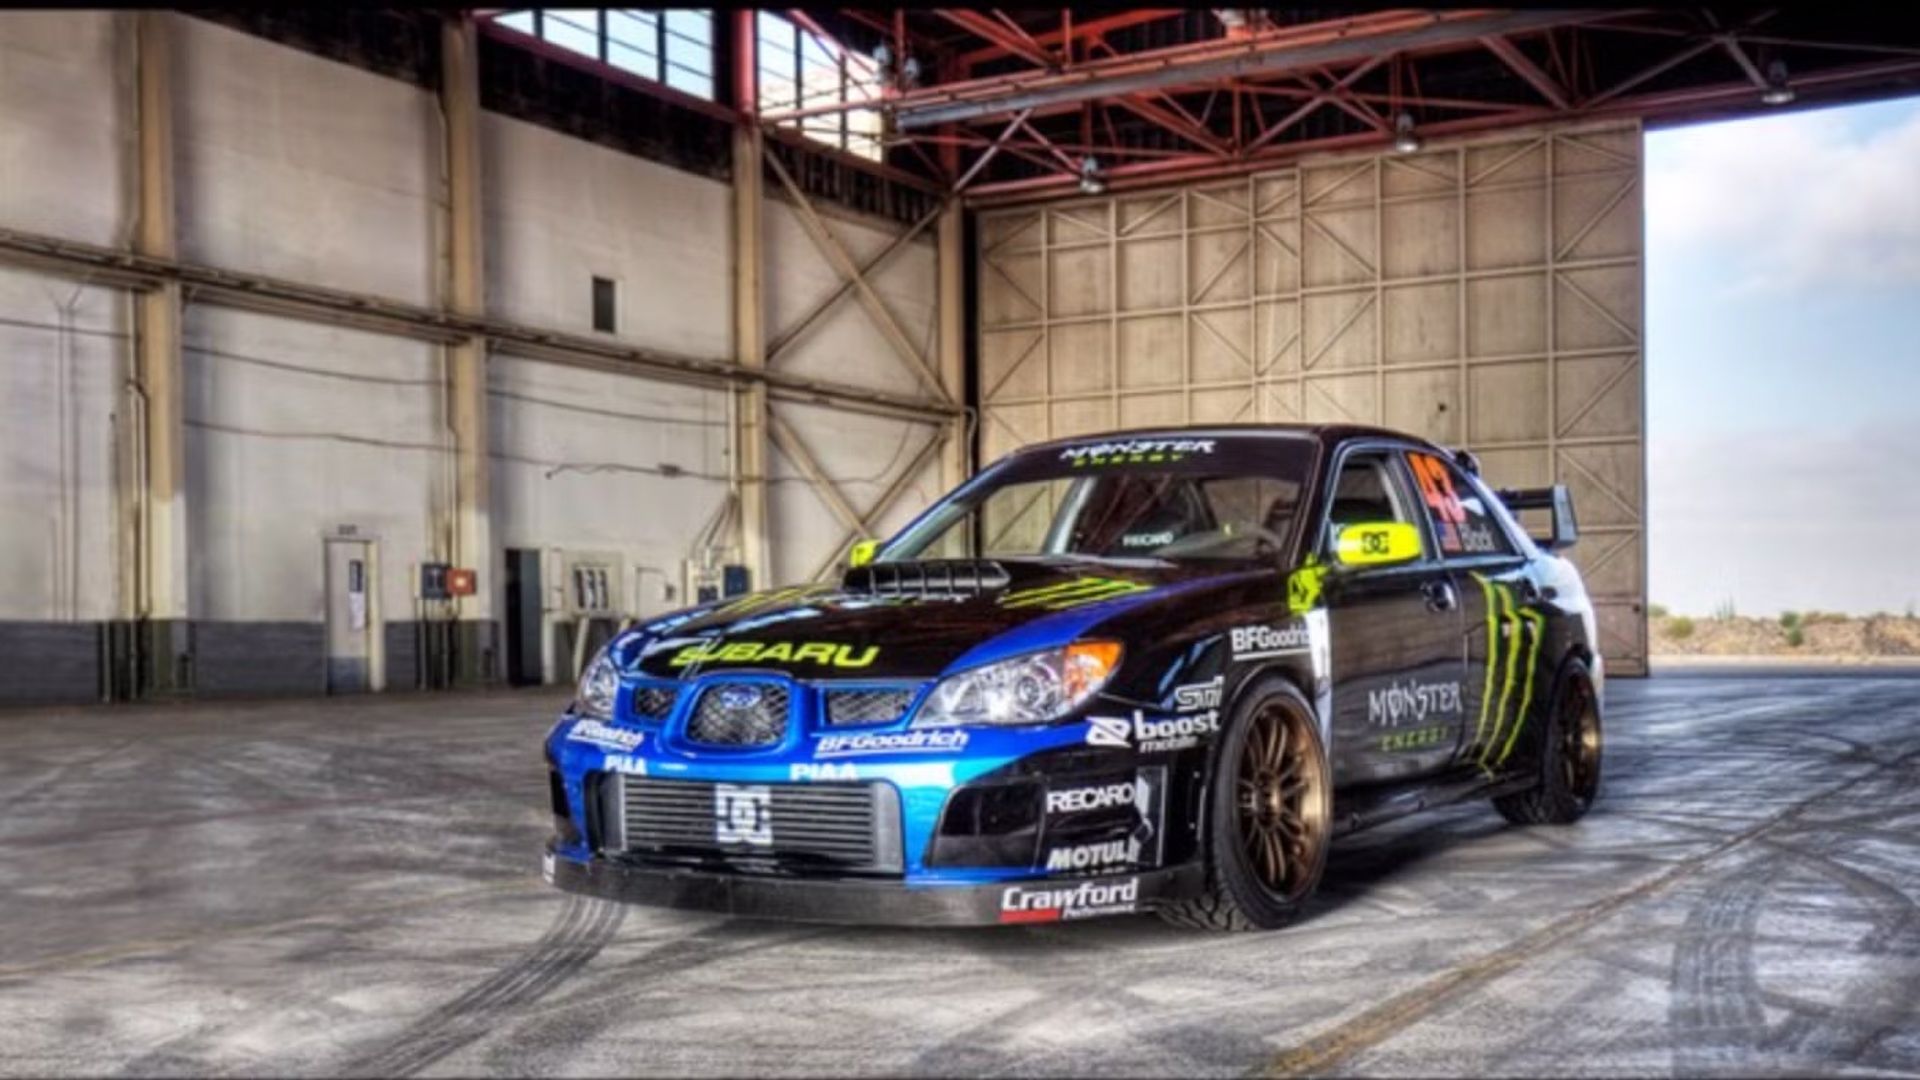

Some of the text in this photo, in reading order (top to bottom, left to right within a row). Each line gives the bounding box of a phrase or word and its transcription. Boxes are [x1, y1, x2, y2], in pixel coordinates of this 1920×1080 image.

[668, 643, 880, 667] SUBARU
[1134, 709, 1220, 740] boost
[1046, 783, 1135, 813] RECARO
[1002, 877, 1139, 911] Crawford
